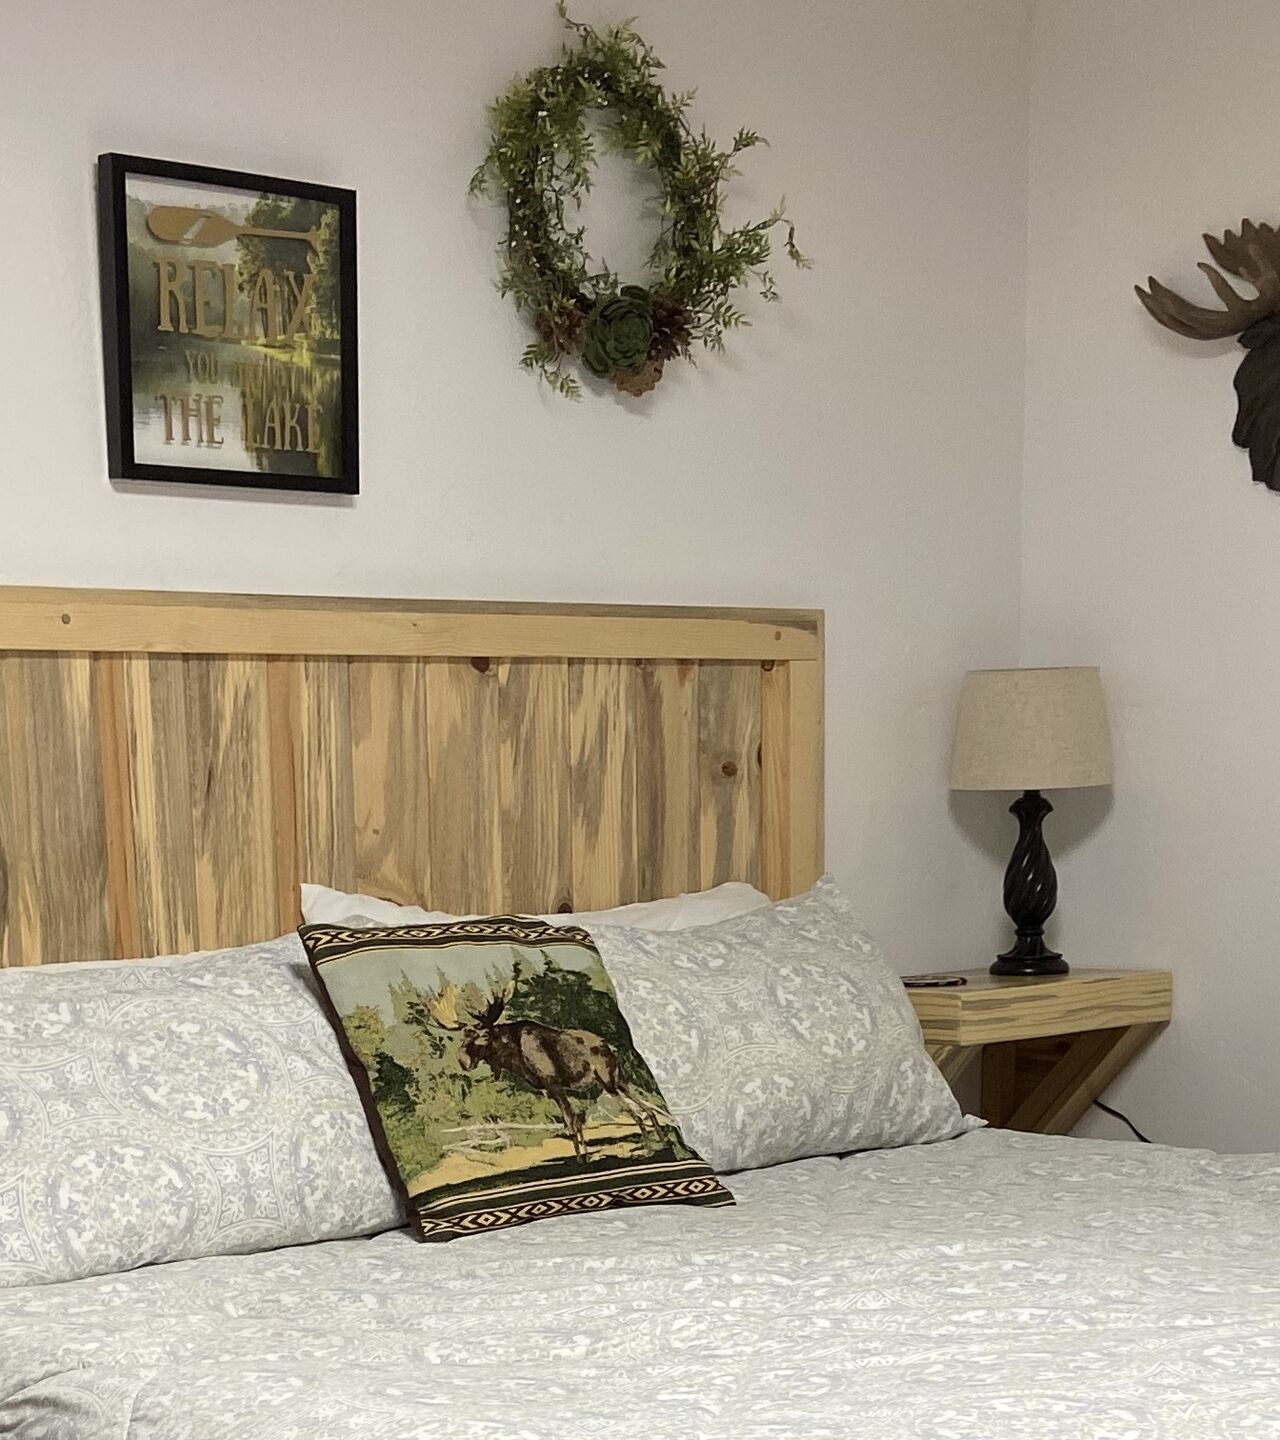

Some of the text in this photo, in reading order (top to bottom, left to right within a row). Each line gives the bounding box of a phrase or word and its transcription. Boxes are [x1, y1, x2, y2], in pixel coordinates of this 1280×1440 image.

[154, 255, 319, 344] RELAX
[155, 391, 322, 453] THE LAKE
